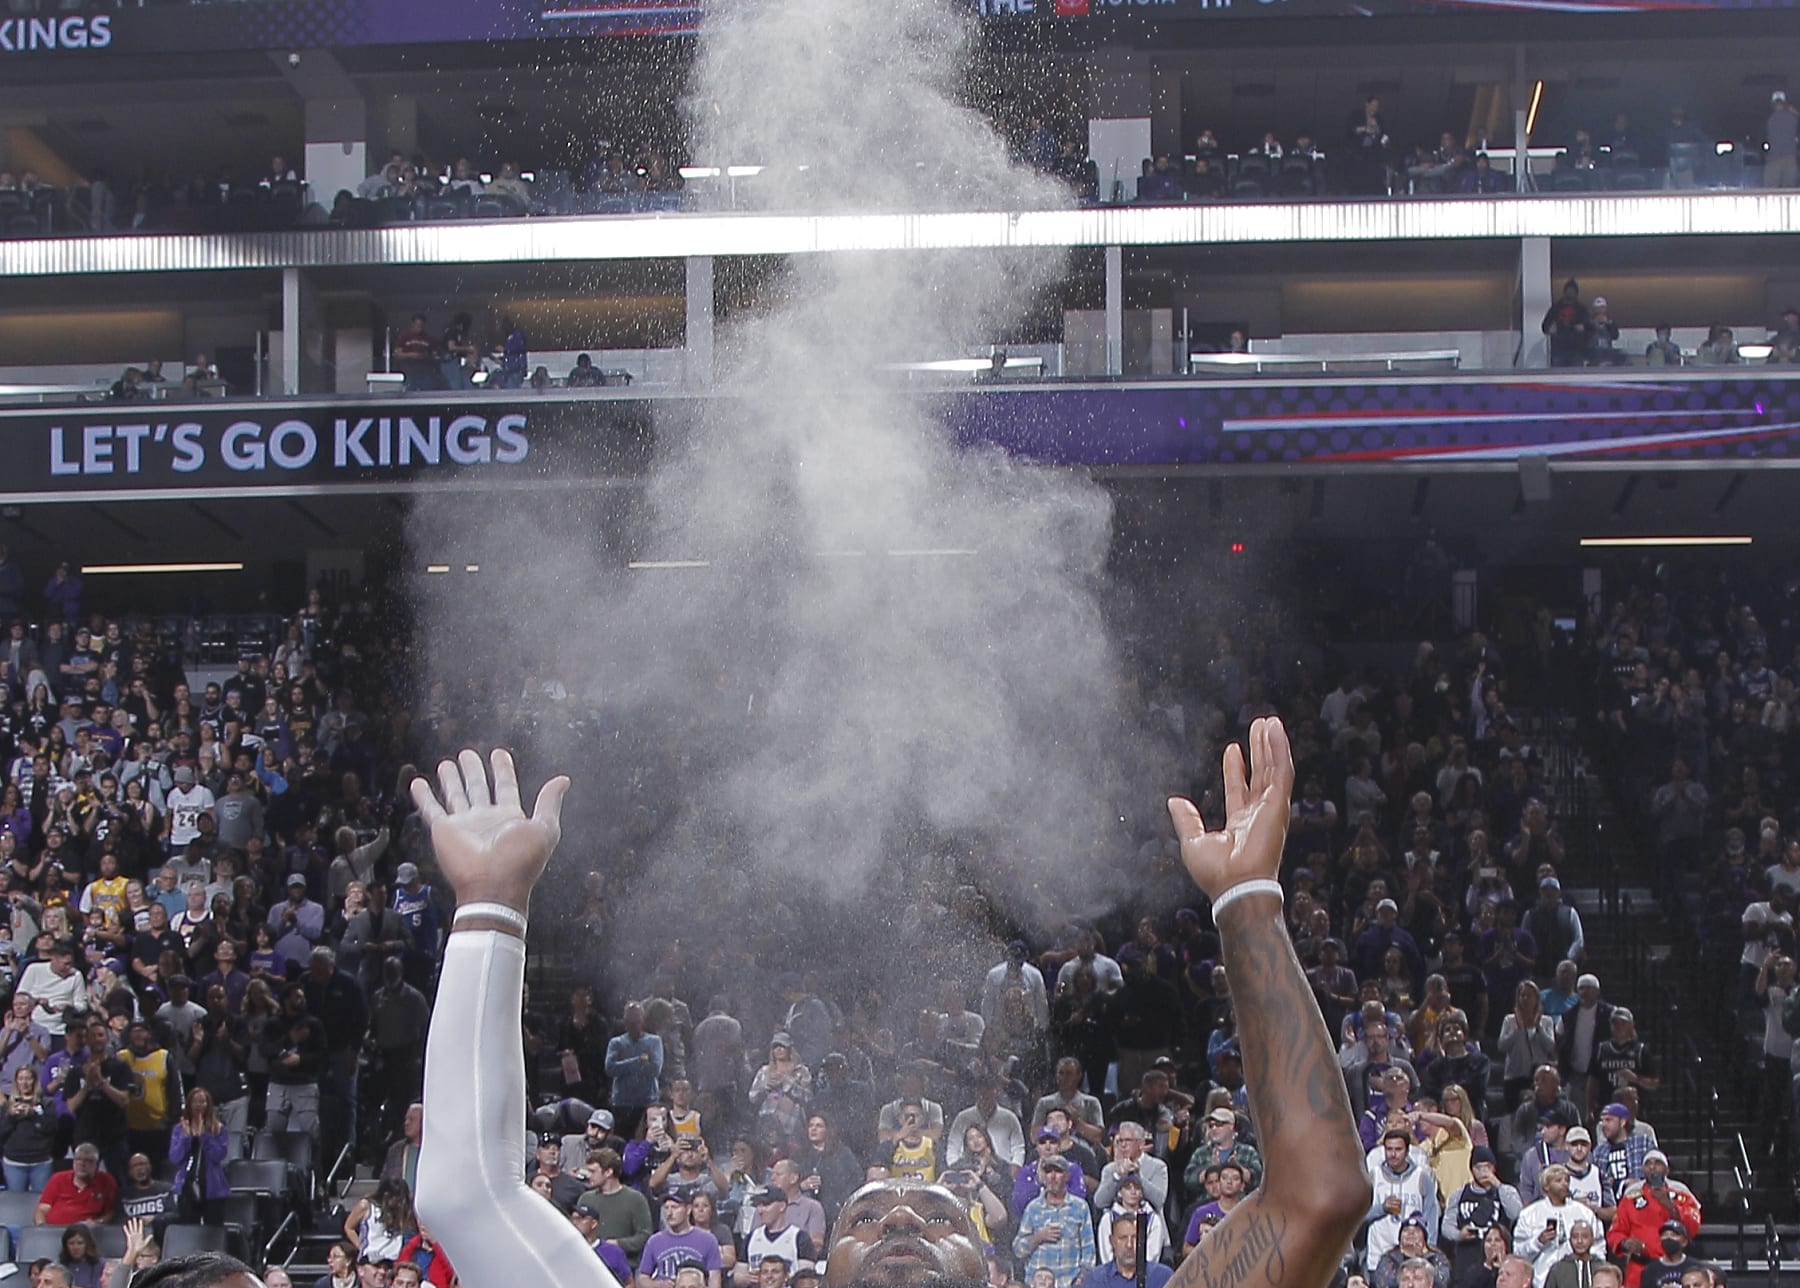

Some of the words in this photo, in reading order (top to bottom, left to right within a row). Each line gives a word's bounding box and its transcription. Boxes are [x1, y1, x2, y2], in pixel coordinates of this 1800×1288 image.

[50, 423, 205, 475] LET'S
[221, 420, 317, 471] GO
[334, 415, 528, 467] KINGS
[179, 812, 196, 827] 24
[412, 914, 422, 927] 5
[123, 1199, 164, 1216] KINGS
